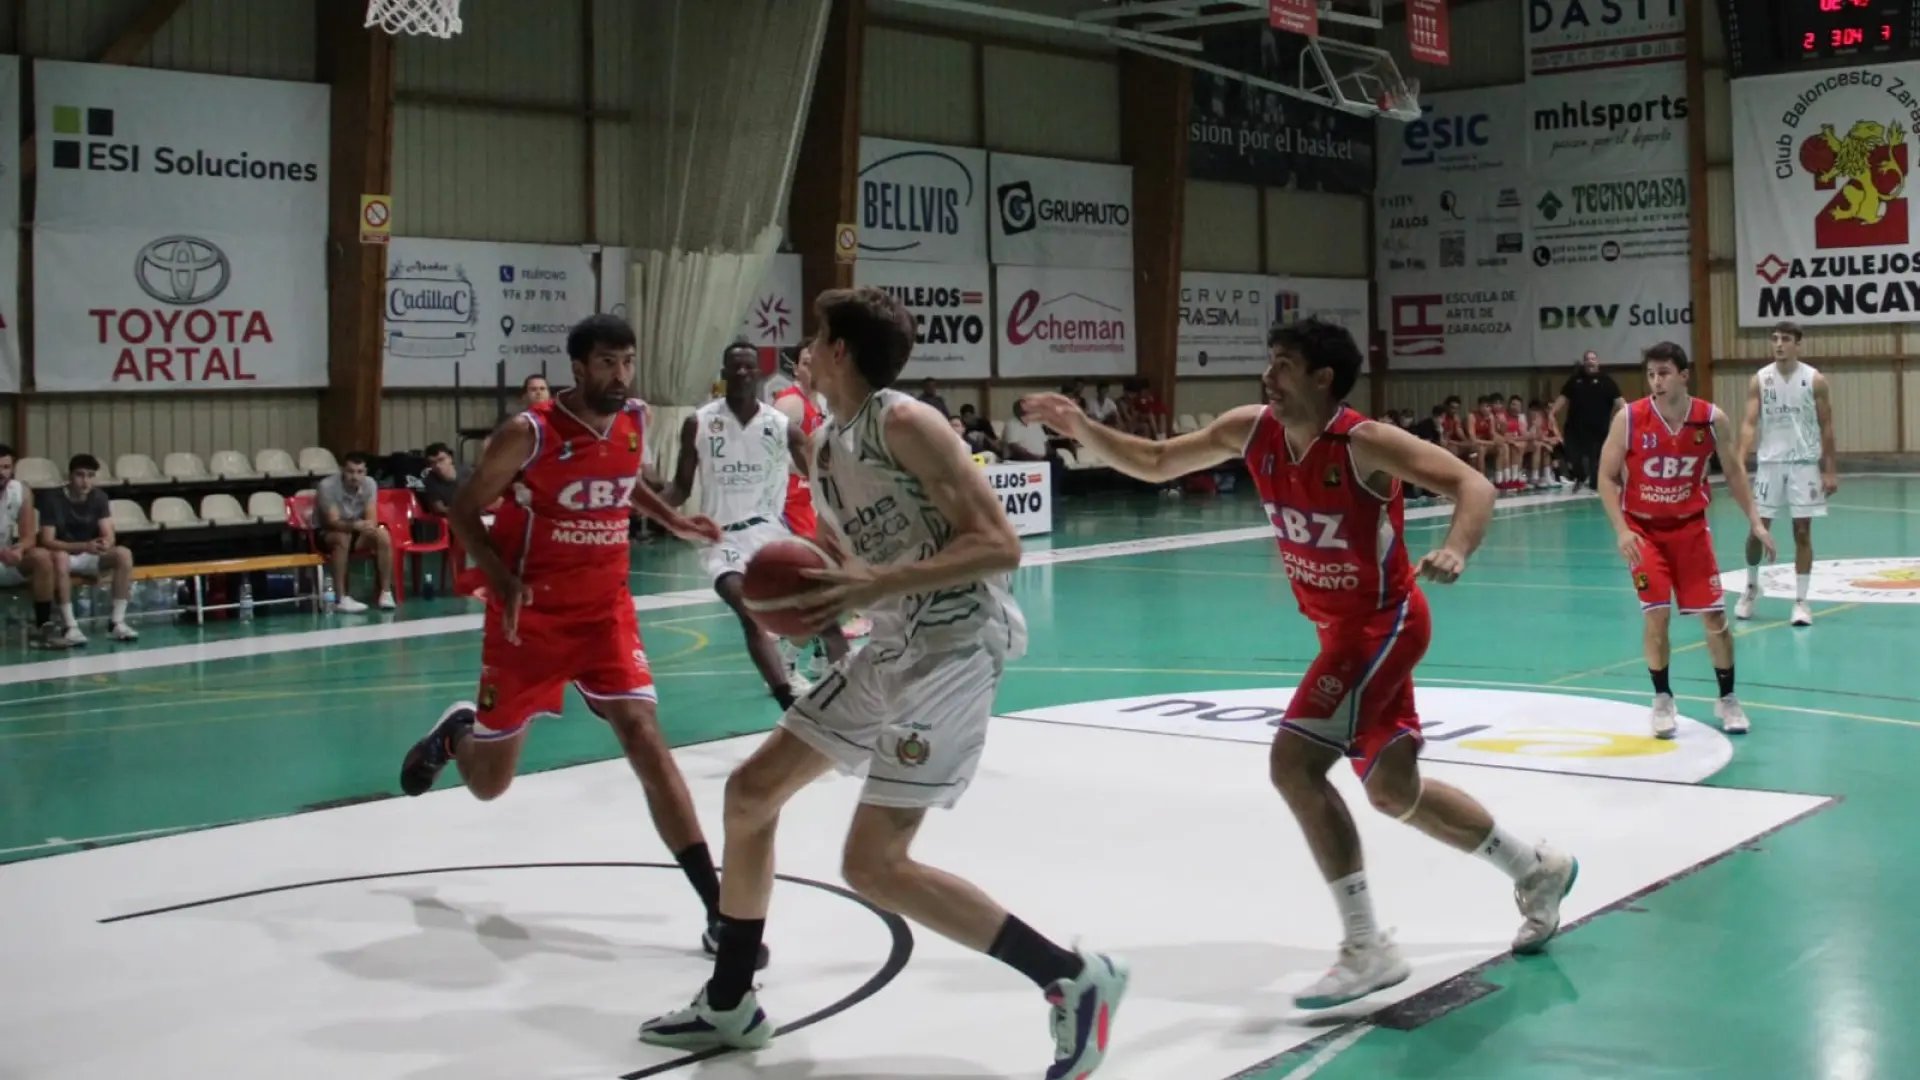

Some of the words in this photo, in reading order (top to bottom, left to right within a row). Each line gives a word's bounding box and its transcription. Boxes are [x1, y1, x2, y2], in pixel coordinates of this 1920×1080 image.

[1534, 94, 1688, 131] mhlsports
[1782, 69, 1882, 128] Baloncesto
[1238, 129, 1271, 156] por
[1275, 126, 1292, 152] el
[1776, 134, 1793, 179] Club
[88, 143, 139, 172] ESI
[154, 147, 318, 182] Soluciones
[864, 181, 959, 235] BELLVIS
[1038, 198, 1129, 225] GRUPAUTO
[1571, 177, 1687, 214] TECNOCASA
[88, 308, 274, 344] TOYOTA
[1447, 323, 1512, 334] ZARAGOZA
[1539, 304, 1620, 331] DKV
[1629, 301, 1695, 327] Salud
[112, 348, 256, 382] ARTAL
[709, 436, 726, 458] 12
[1643, 455, 1699, 479] CBZ
[557, 476, 637, 511] CBZ
